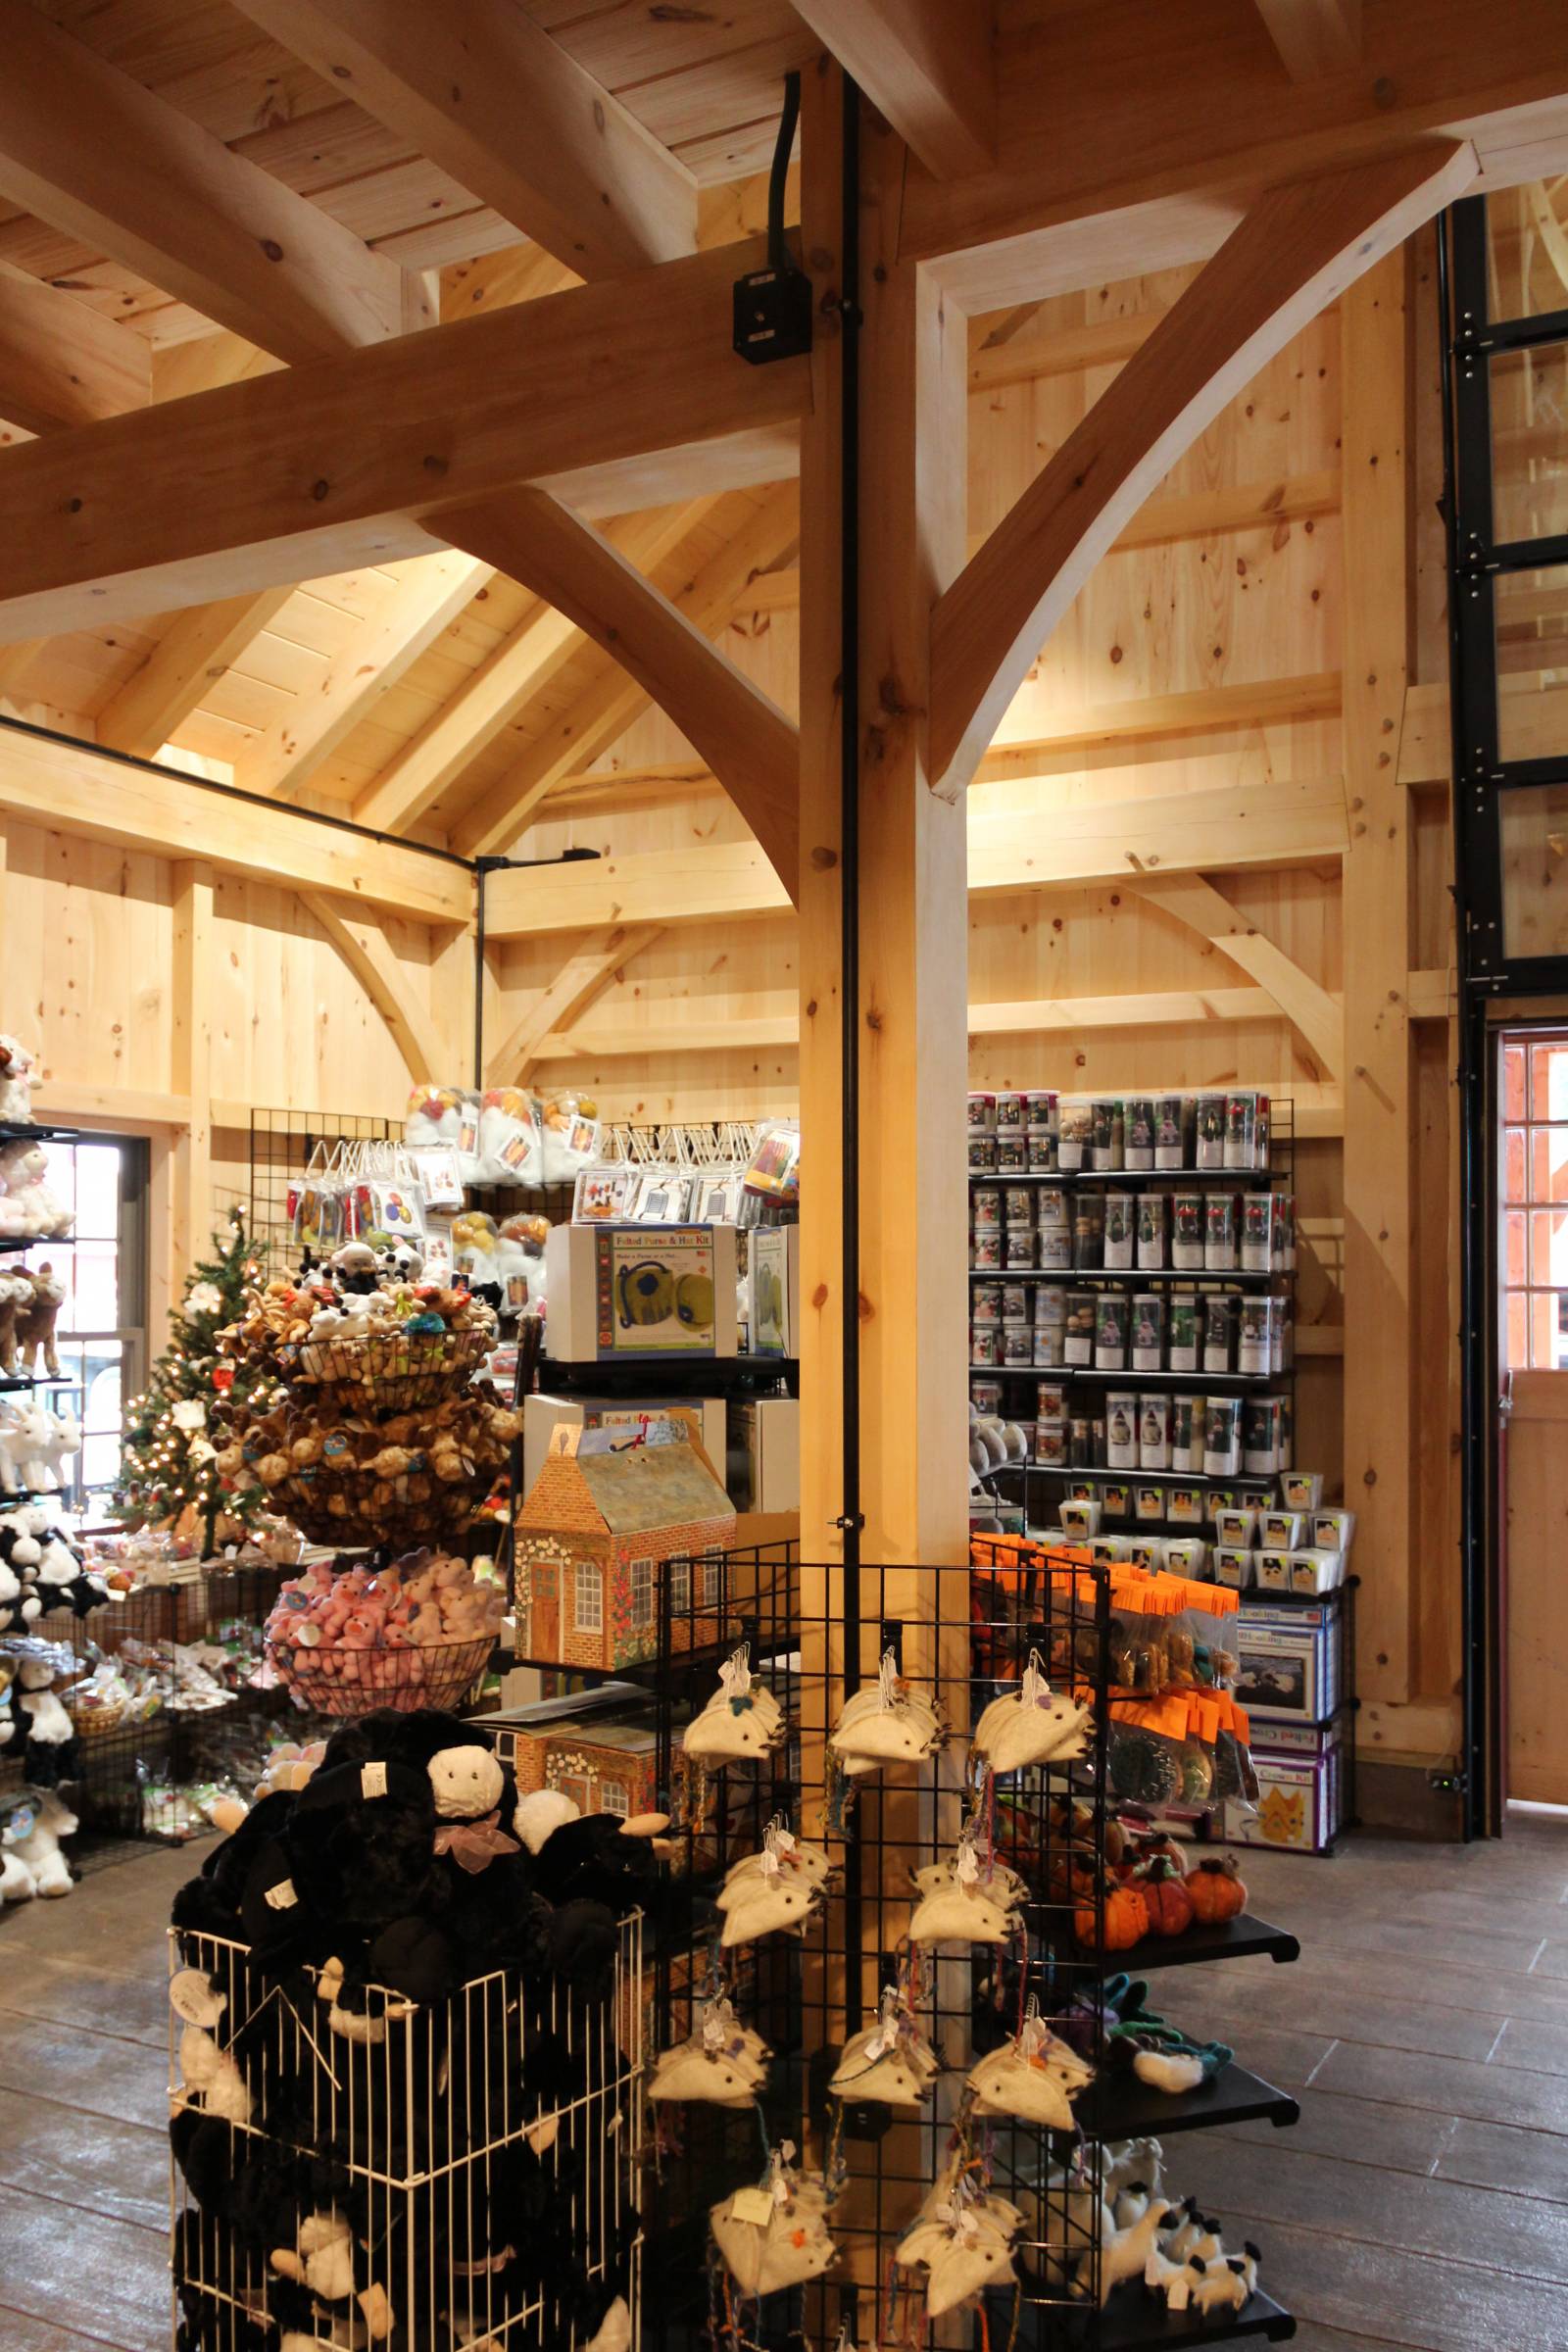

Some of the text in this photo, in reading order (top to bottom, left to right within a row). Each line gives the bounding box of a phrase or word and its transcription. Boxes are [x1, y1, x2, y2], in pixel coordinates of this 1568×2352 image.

[645, 1236, 666, 1245] Purse
[668, 1236, 676, 1245] &
[679, 1236, 693, 1245] Hat
[696, 1235, 710, 1245] Kit
[606, 1416, 631, 1426] Felted
[1281, 1730, 1315, 1743] Felted
[1296, 1771, 1311, 1783] Kit
